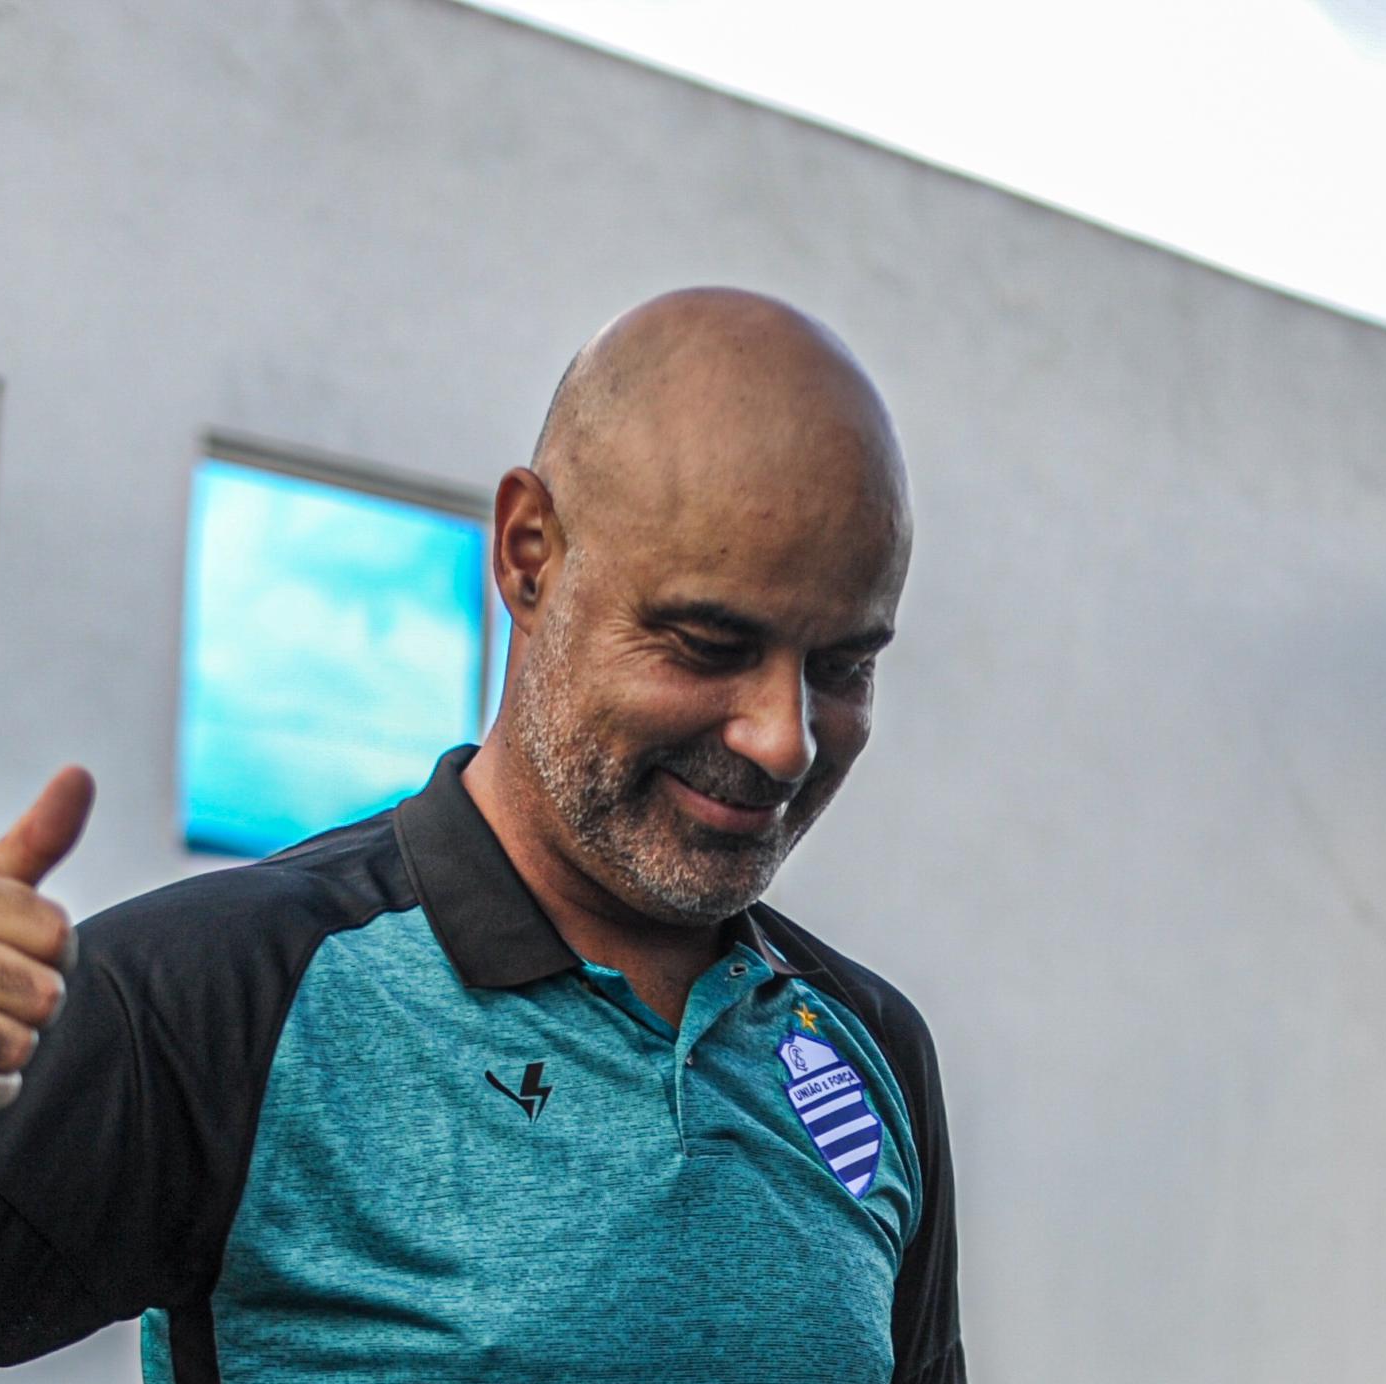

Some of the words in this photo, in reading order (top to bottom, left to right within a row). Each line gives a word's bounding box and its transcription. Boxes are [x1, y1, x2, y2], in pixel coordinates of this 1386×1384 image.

[793, 1082, 822, 1101] UNIÃO
[822, 1080, 830, 1090] E
[827, 1070, 856, 1086] FORÇA
